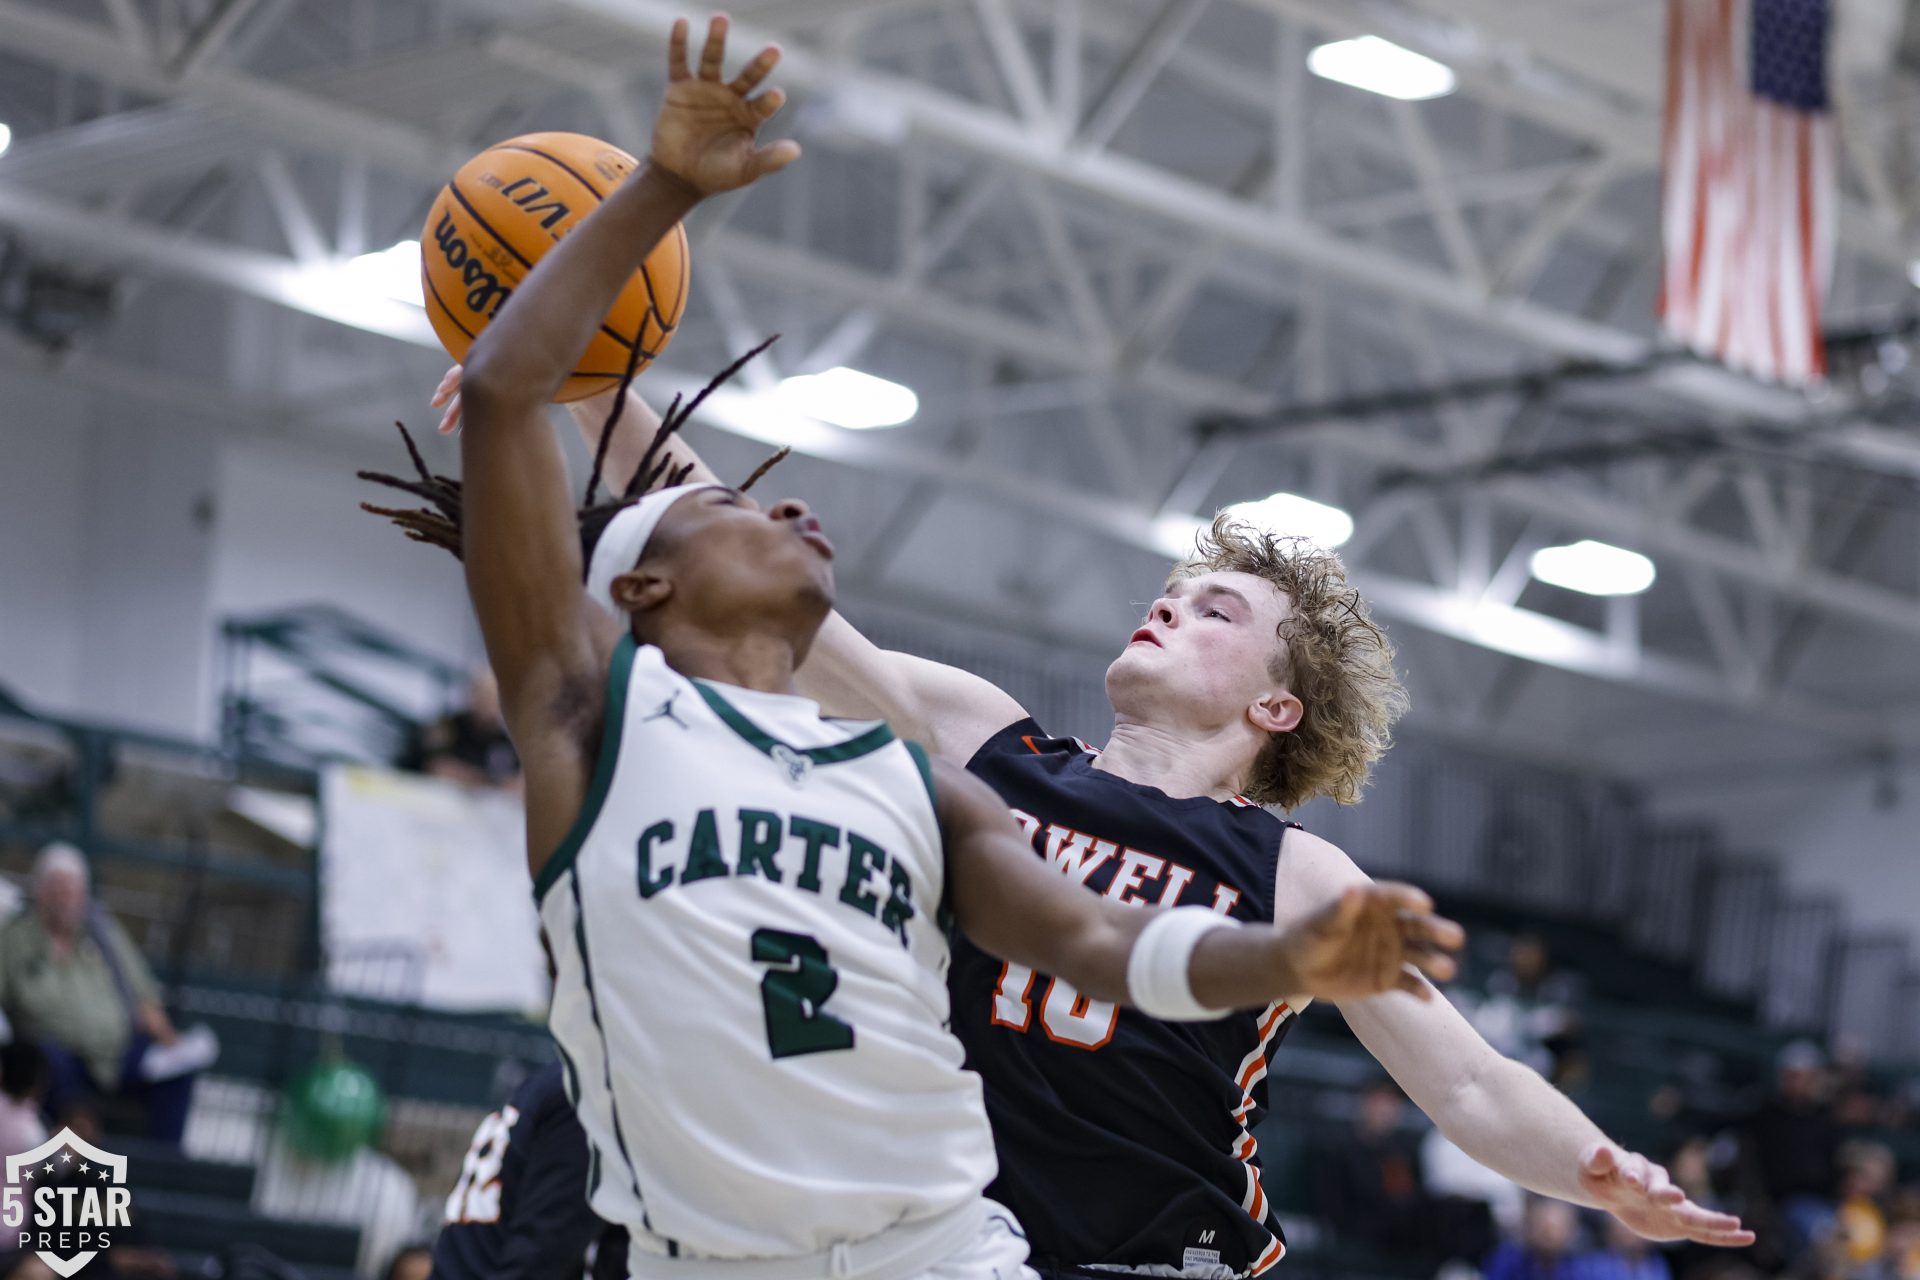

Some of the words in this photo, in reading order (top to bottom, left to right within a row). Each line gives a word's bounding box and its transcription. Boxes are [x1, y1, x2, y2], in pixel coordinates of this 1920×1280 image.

[434, 210, 513, 322] ilson
[636, 806, 915, 950] CARTER
[750, 926, 855, 1060] 2
[1198, 1229, 1216, 1244] M
